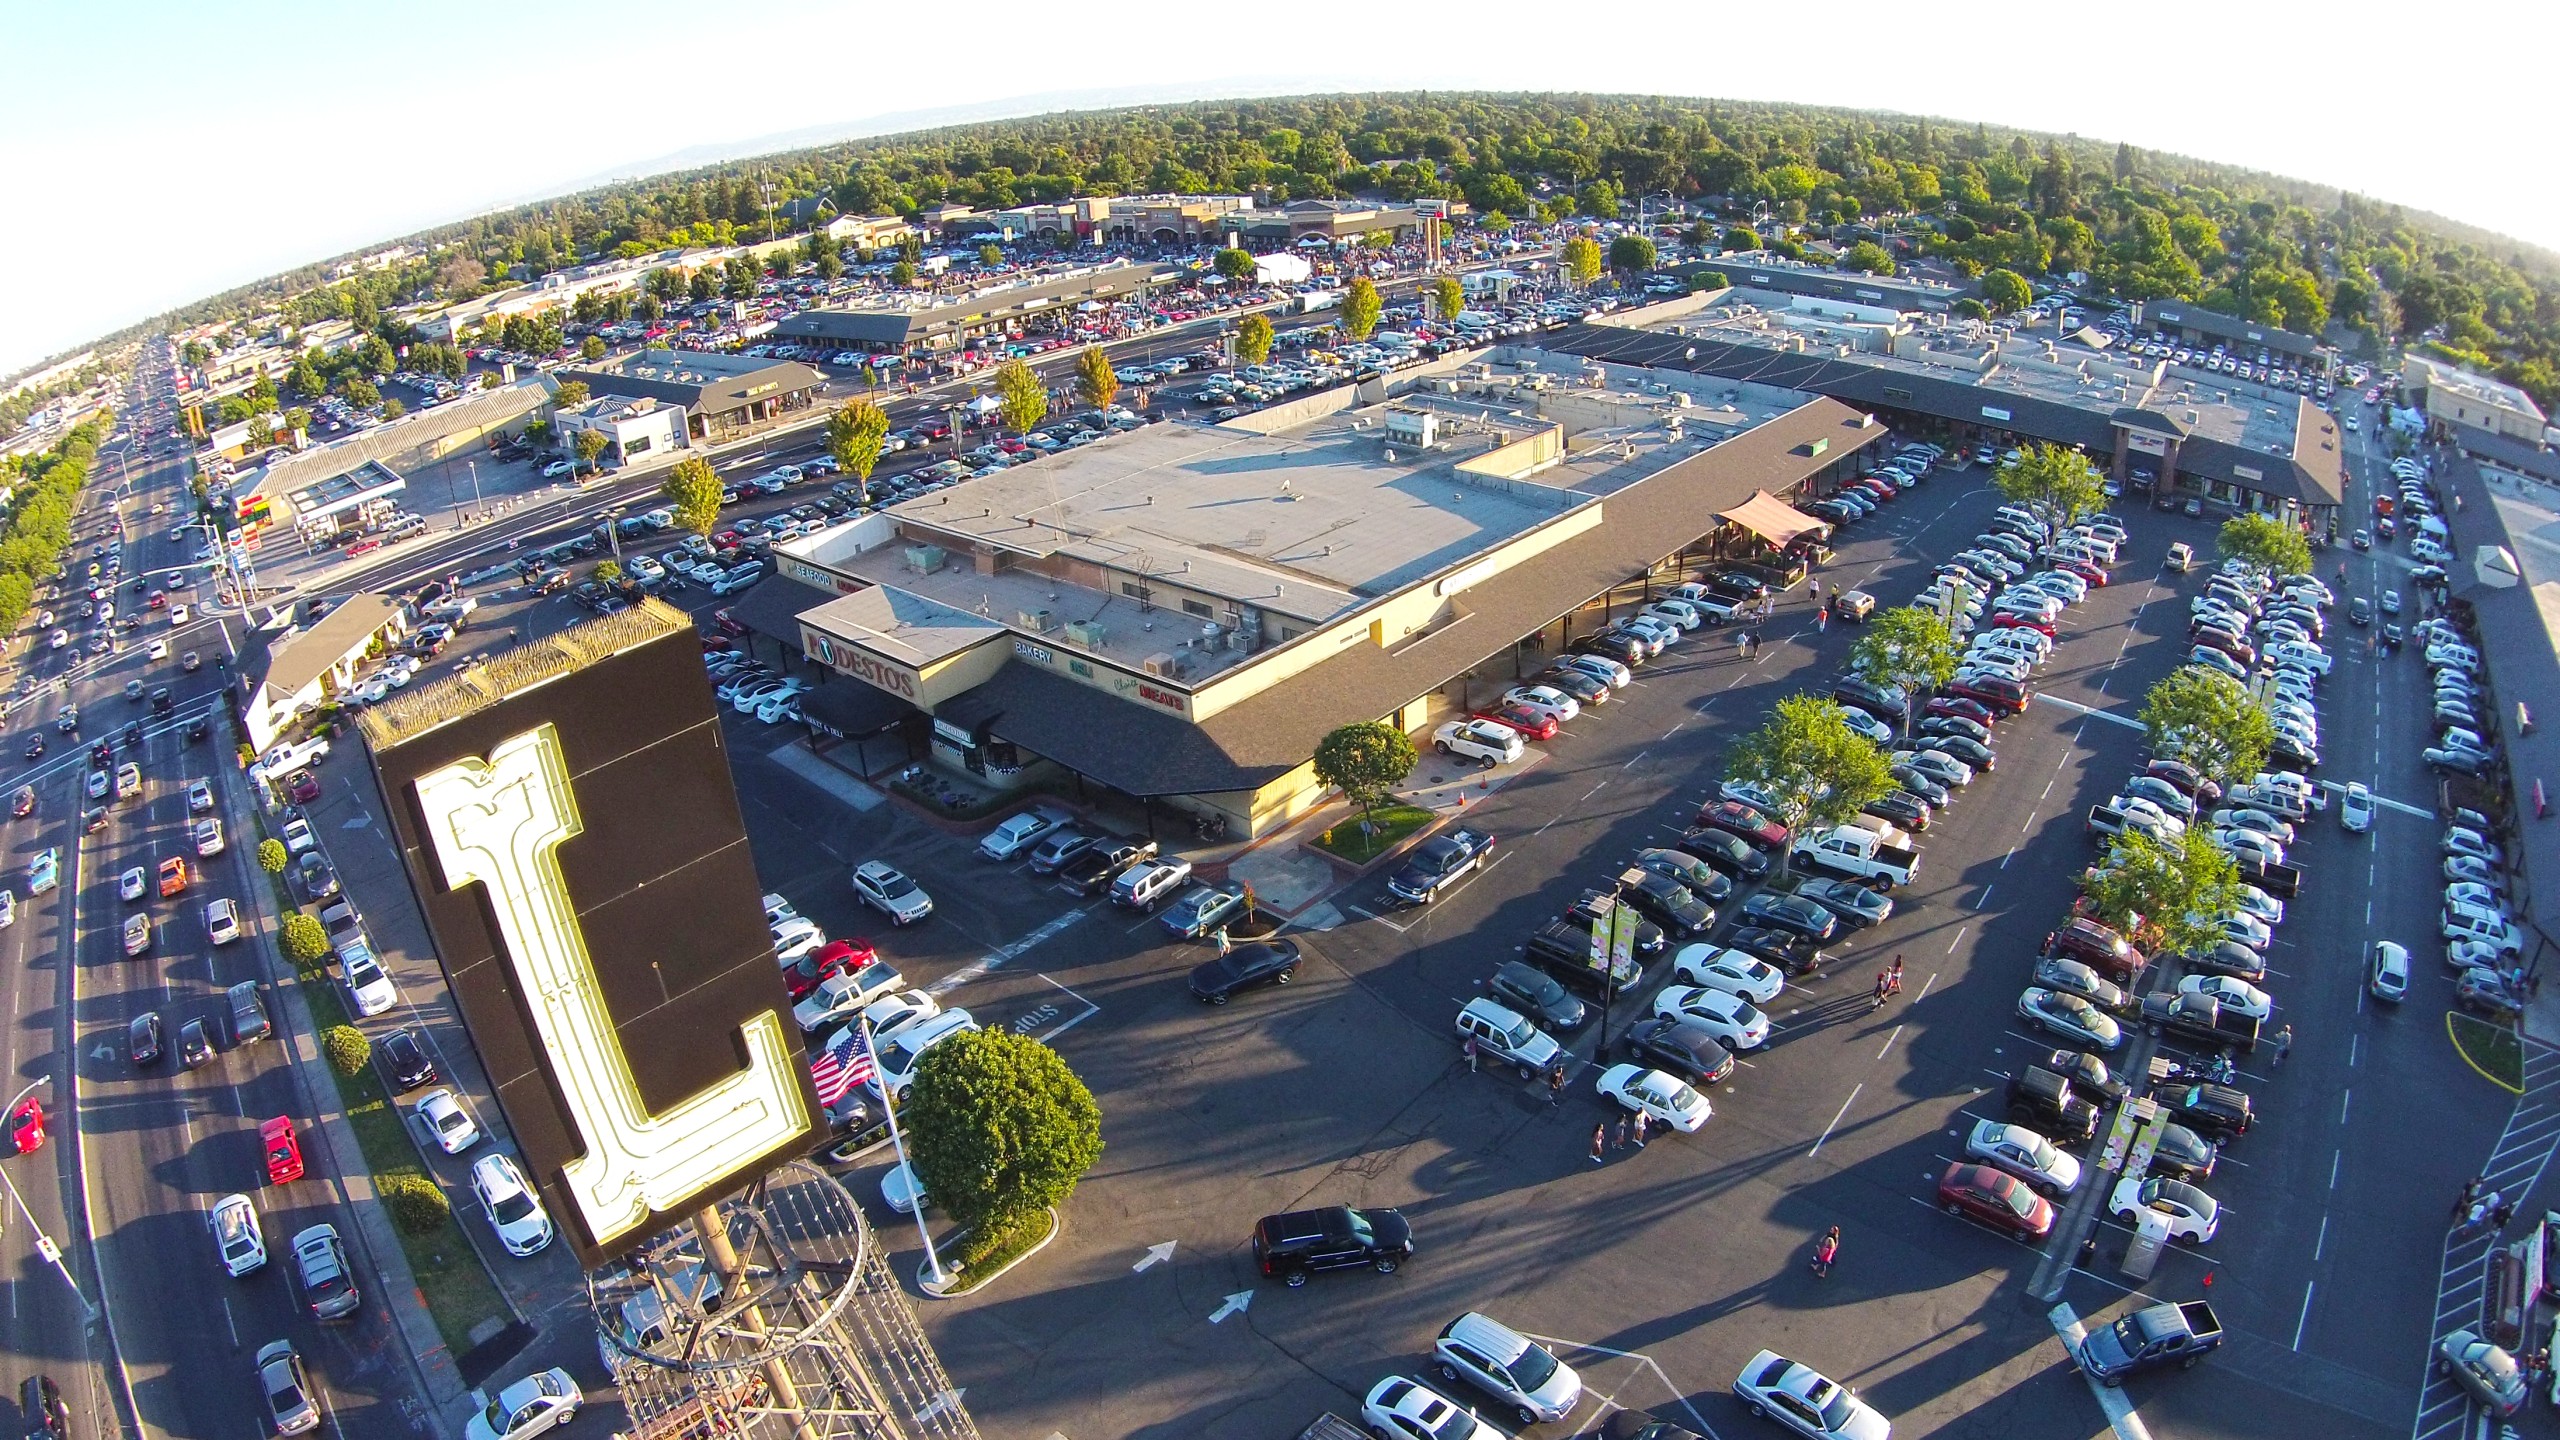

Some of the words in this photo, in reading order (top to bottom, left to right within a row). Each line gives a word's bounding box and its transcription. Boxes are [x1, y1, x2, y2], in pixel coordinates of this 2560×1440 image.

[796, 565, 832, 586] SEAFOOD
[1014, 641, 1052, 664] BAKERY
[1139, 684, 1185, 711] MEATS
[414, 722, 812, 1246] L
[1014, 1004, 1059, 1034] STOP
